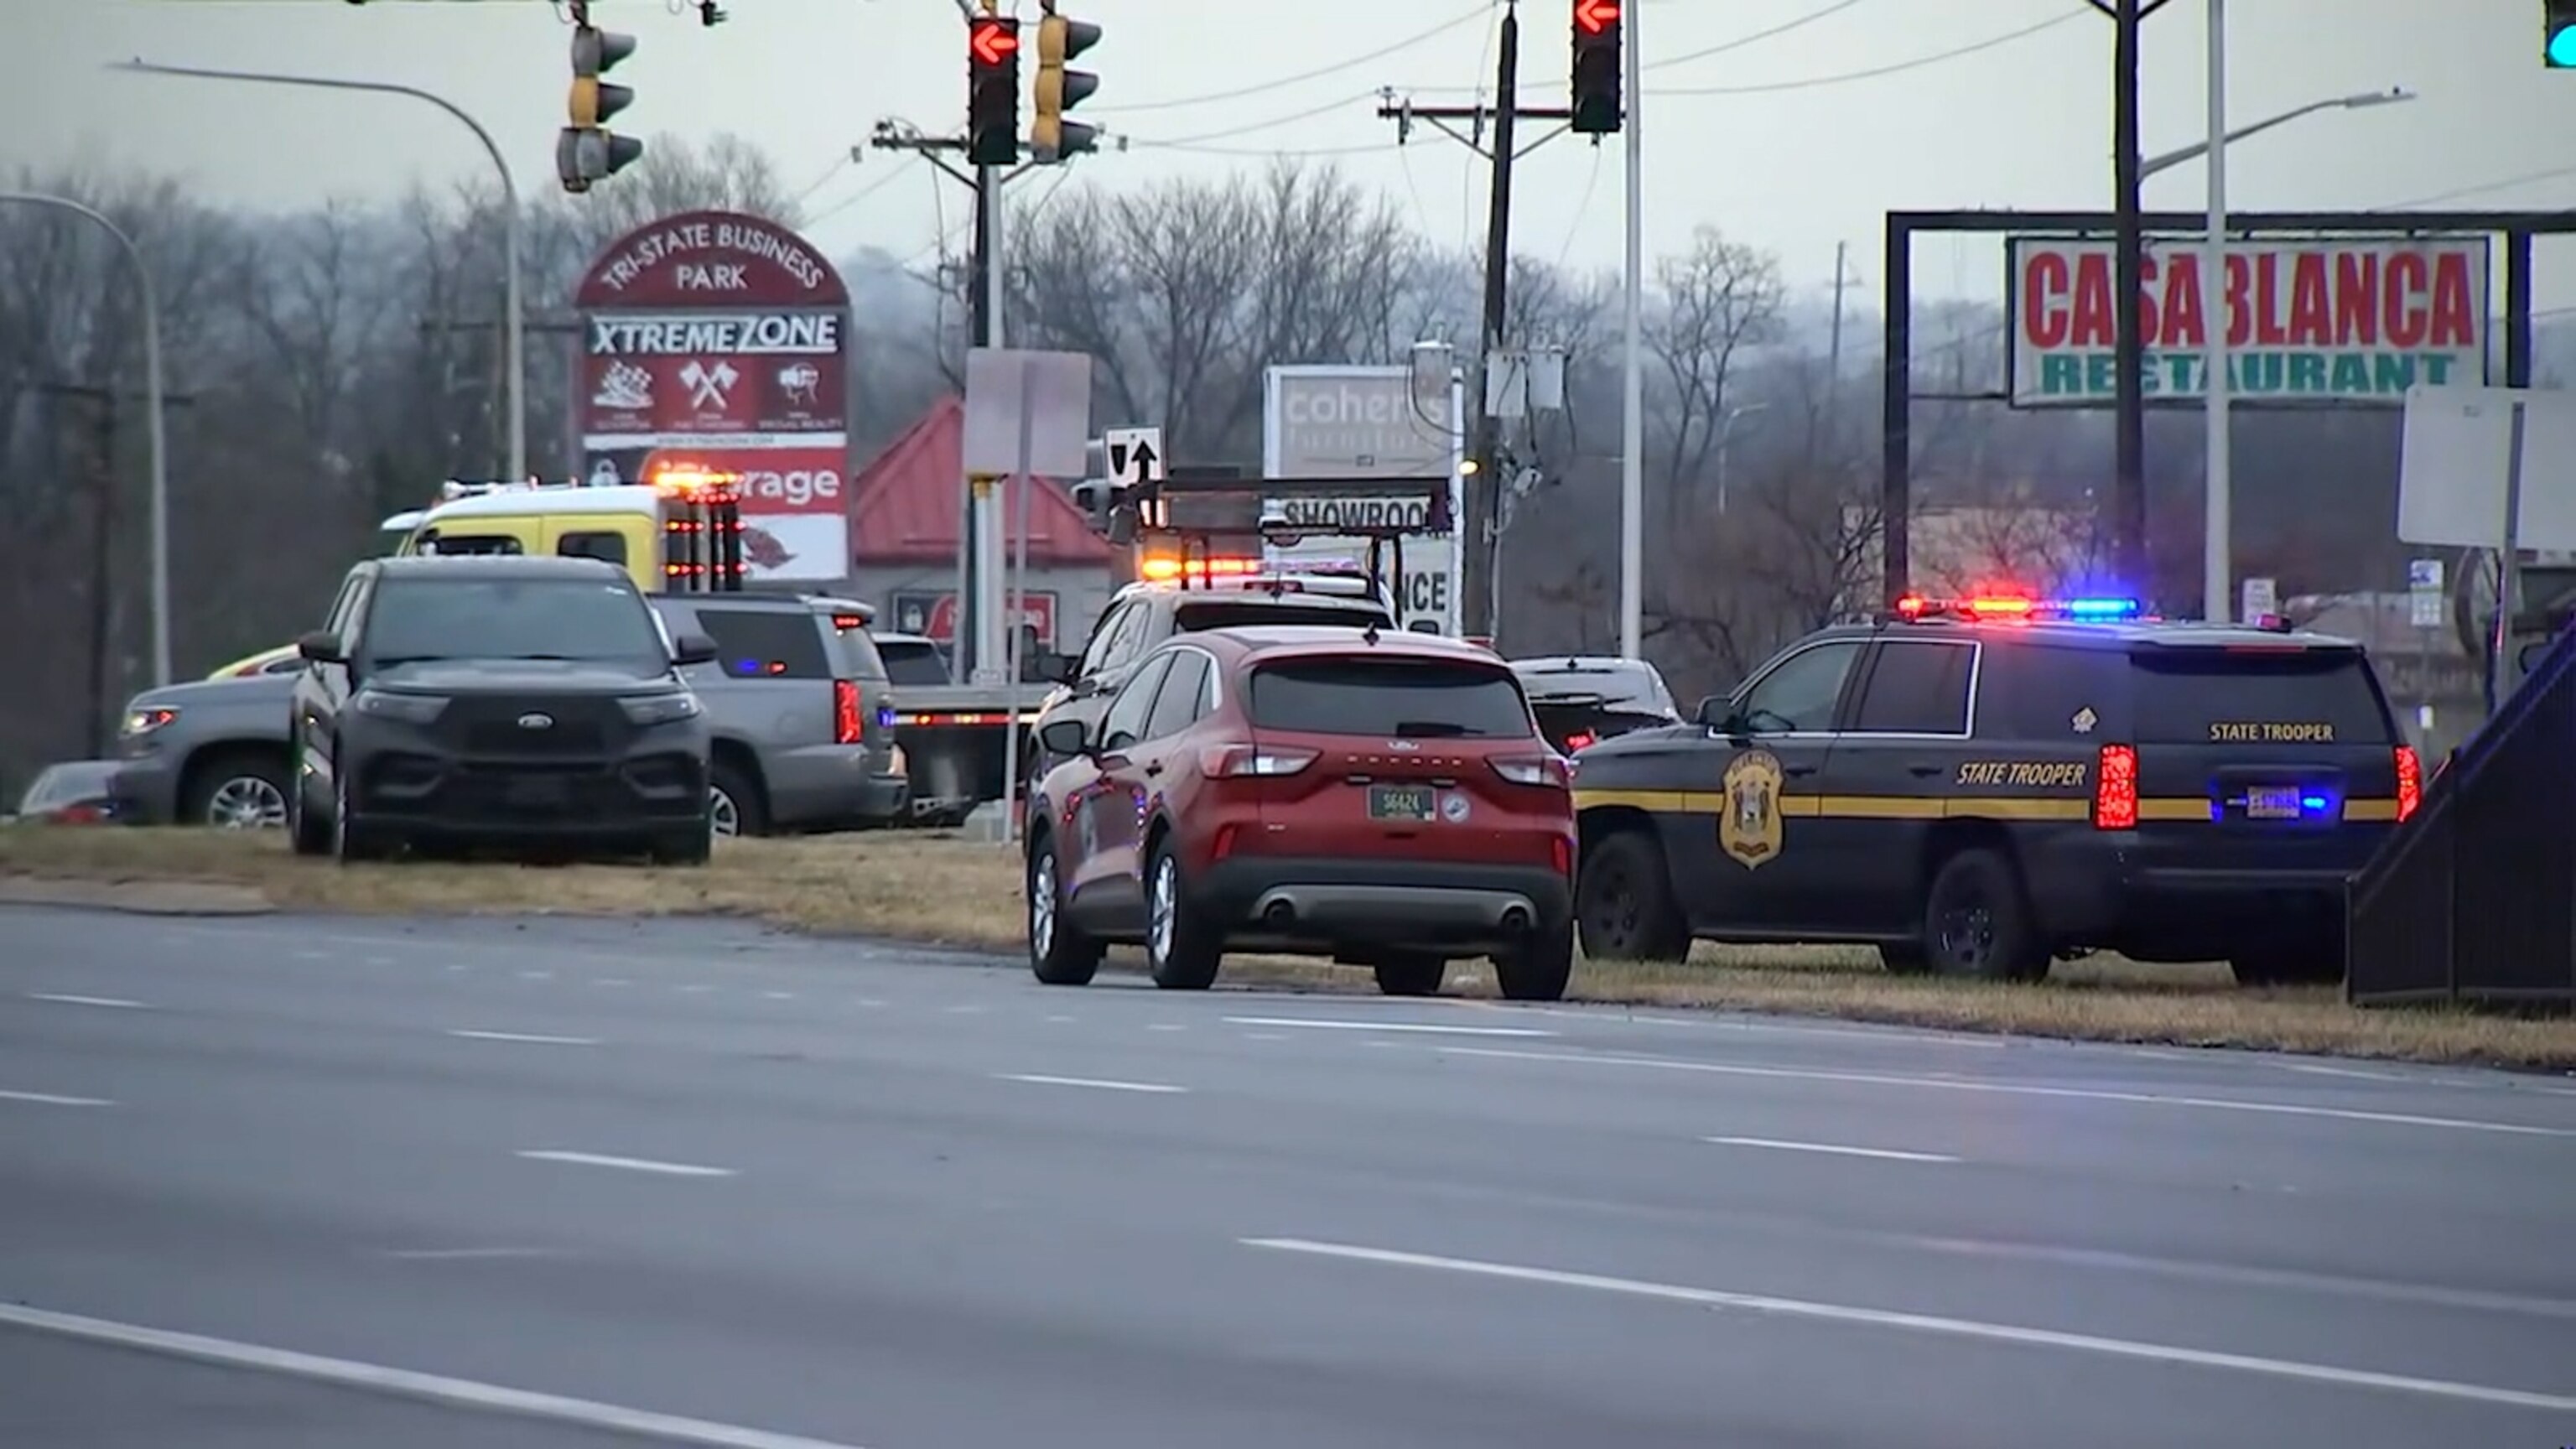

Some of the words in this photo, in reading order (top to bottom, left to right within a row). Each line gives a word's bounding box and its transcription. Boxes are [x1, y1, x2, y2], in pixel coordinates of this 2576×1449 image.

[601, 224, 711, 291] TRI-STATE
[718, 224, 824, 289] BUSINESS
[676, 264, 748, 289] PARK
[2024, 250, 2475, 349] CASABLANCA
[590, 314, 838, 354] XTREMEZONE
[1285, 501, 1431, 533] SHOWROO
[2210, 723, 2258, 741] STATE
[2262, 723, 2334, 742] TROOPER
[1956, 762, 2009, 785] STATE
[2007, 762, 2087, 787] TROOPER
